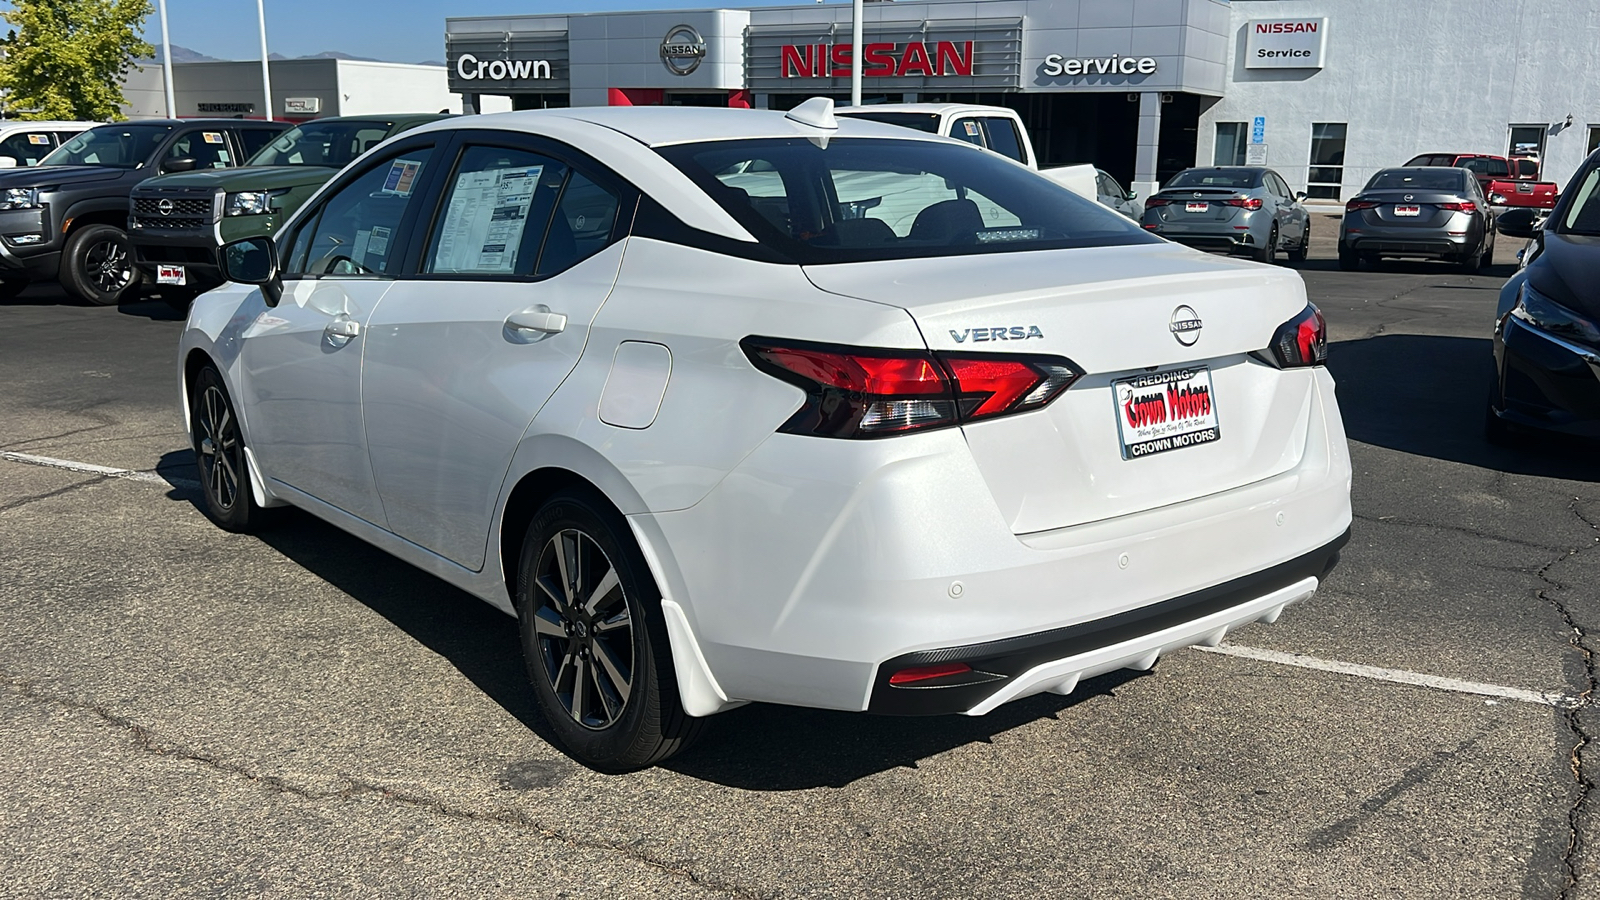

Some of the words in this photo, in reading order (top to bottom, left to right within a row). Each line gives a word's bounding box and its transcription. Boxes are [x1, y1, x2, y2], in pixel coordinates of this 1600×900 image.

[1256, 22, 1318, 34] NISSAN
[662, 45, 700, 55] NISSAN
[781, 40, 974, 78] NISSAN
[1257, 48, 1311, 58] Service
[457, 53, 550, 80] Crown
[1043, 53, 1157, 76] Service
[949, 325, 1044, 343] VERSA
[1171, 320, 1203, 331] NISSAN
[1139, 370, 1190, 387] REDDING
[1124, 391, 1167, 429] Crown
[1167, 384, 1211, 422] Motors
[1132, 438, 1171, 456] CROWN
[1172, 429, 1215, 447] MOTORS
